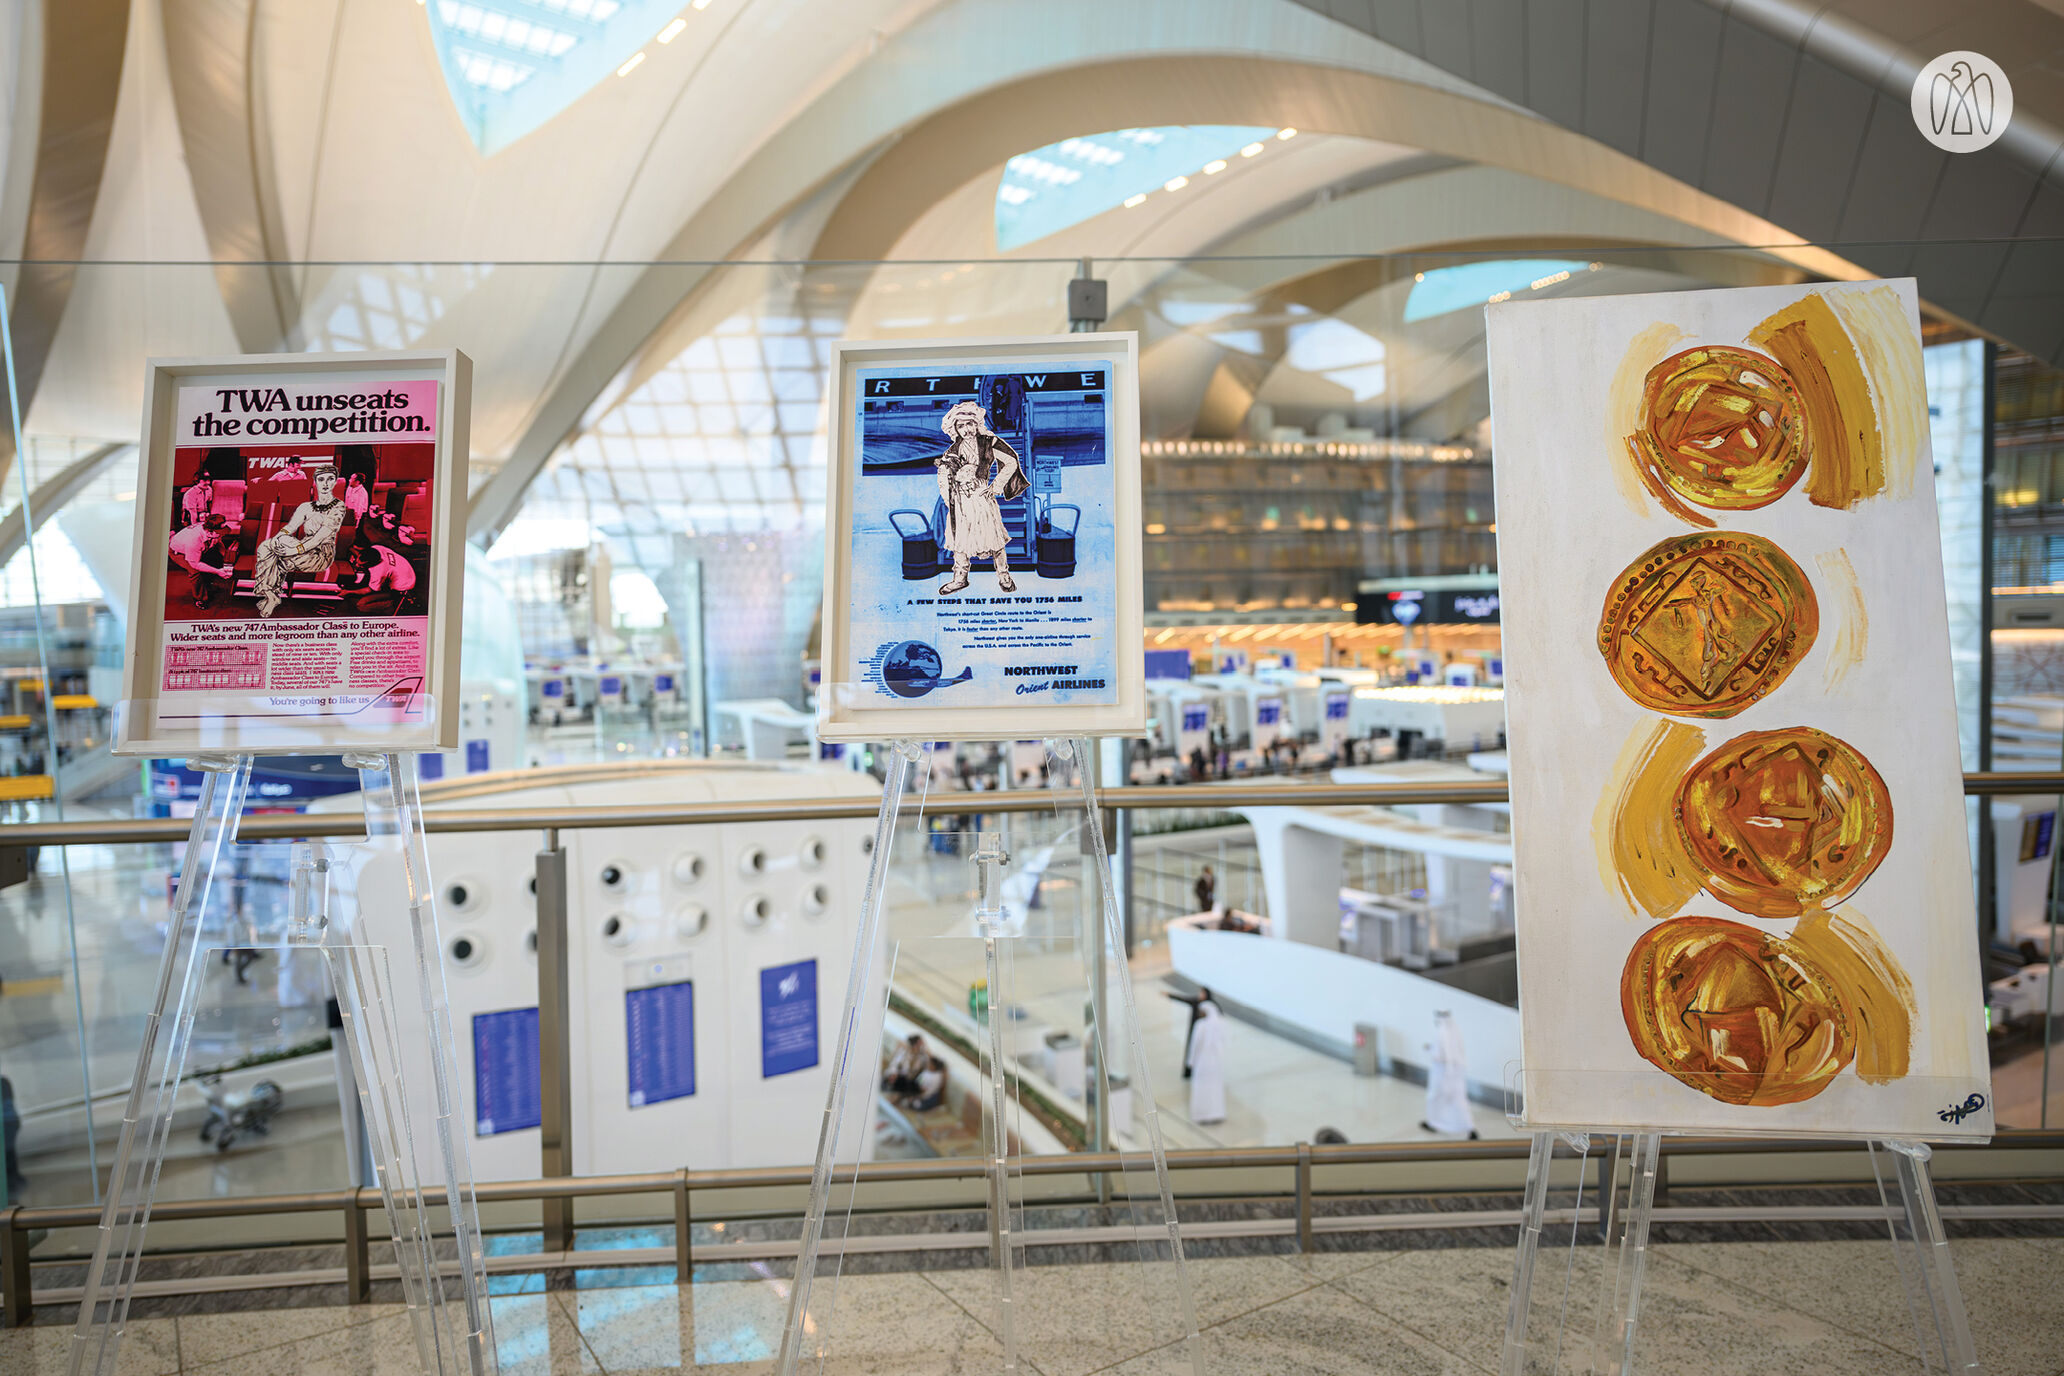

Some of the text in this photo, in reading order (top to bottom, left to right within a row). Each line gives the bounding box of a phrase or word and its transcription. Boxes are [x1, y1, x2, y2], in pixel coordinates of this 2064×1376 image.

[216, 388, 409, 413] TWA unseats
[192, 410, 431, 440] the competition.
[248, 457, 286, 469] TWA
[191, 624, 220, 633] TWA's
[244, 623, 260, 632] 747
[260, 622, 319, 632] Ambassador
[322, 621, 348, 630] Class
[362, 621, 399, 630] Europe.
[170, 633, 199, 642] Wider
[201, 633, 226, 641] seats
[228, 632, 246, 640] and
[275, 632, 315, 641] legroom
[317, 631, 338, 639] than
[340, 632, 358, 640] any
[360, 630, 385, 638] other
[387, 629, 420, 637] airline.
[1004, 666, 1078, 676] NORTHWEST
[1016, 679, 1105, 695] Orient AIRLINES
[269, 697, 298, 706] You're
[300, 698, 326, 706] going
[328, 697, 337, 705] to
[339, 696, 357, 705] like
